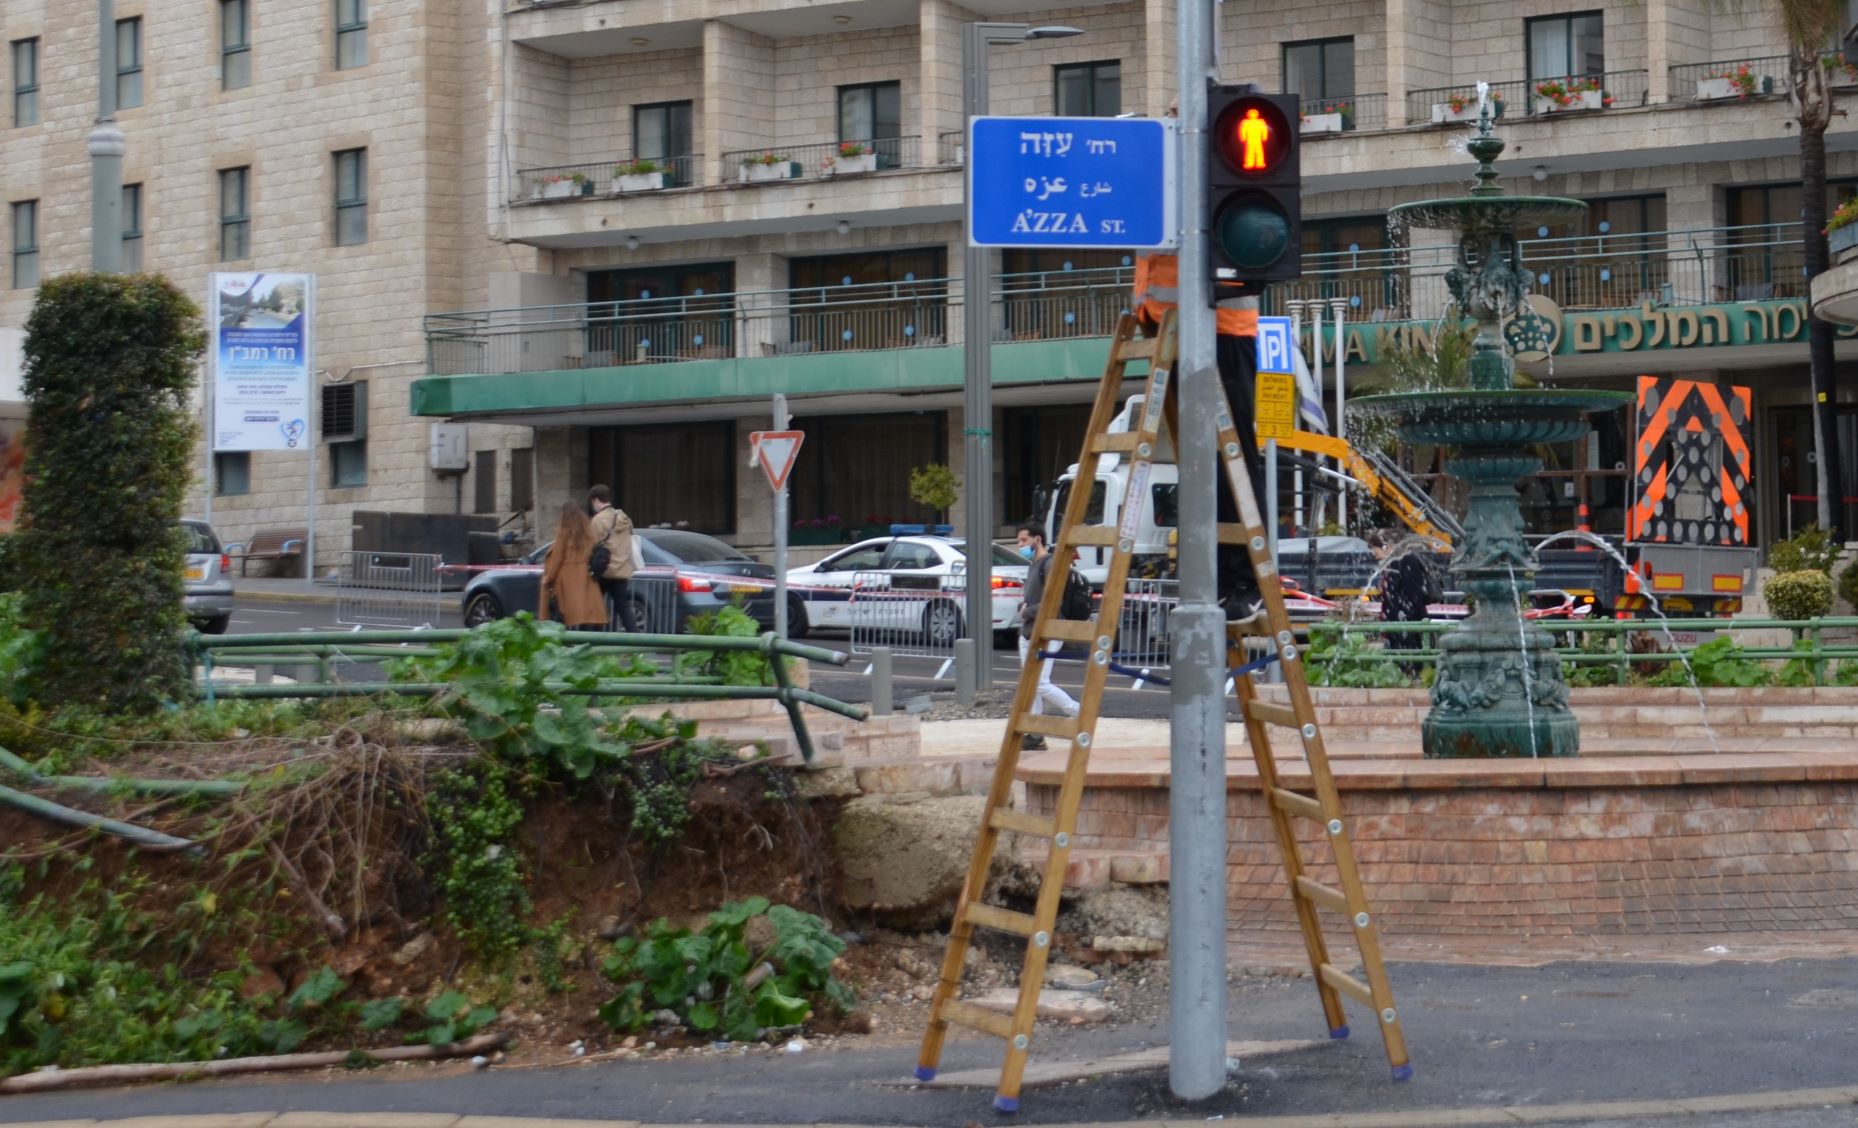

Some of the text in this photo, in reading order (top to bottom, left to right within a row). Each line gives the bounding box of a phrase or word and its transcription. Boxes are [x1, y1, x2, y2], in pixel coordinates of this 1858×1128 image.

[1086, 139, 1117, 154] רח'
[1080, 182, 1112, 198] شارع
[1011, 208, 1126, 233] A'ZZA ST.
[1574, 302, 1729, 351] המלכים
[1266, 335, 1281, 370] P
